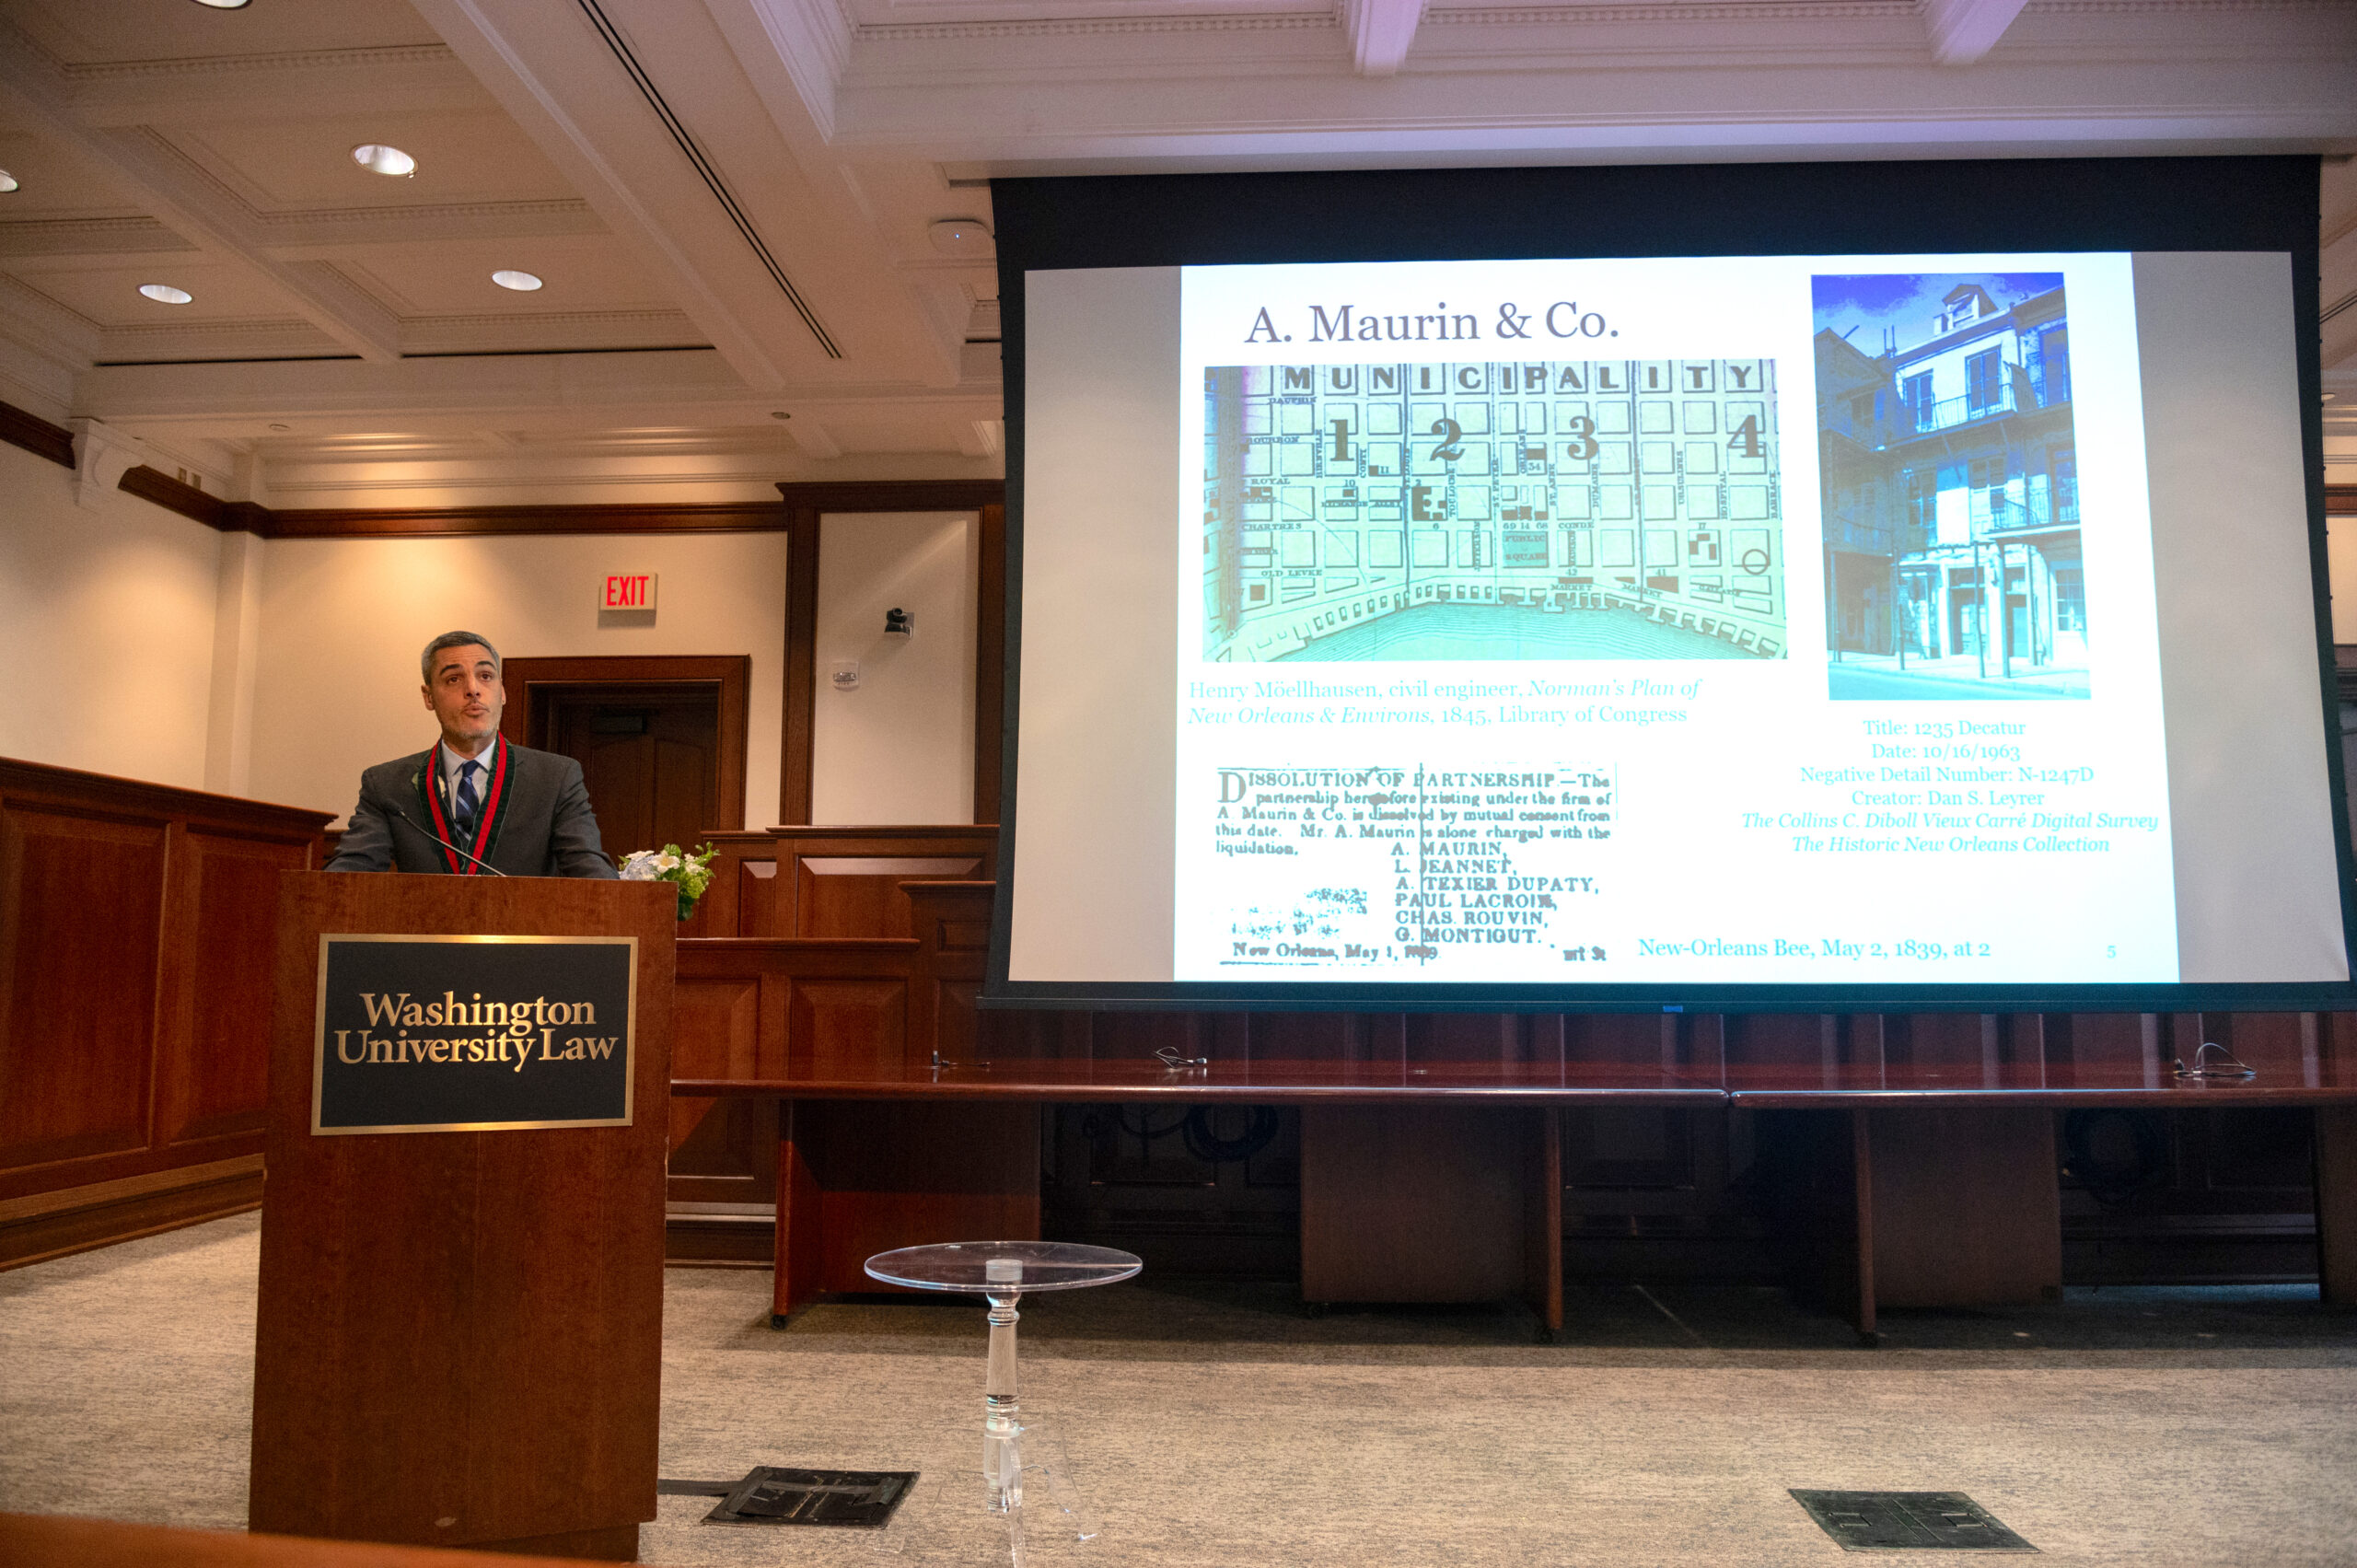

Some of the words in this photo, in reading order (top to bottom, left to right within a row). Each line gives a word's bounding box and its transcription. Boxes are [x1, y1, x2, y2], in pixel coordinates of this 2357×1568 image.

[1245, 307, 1292, 343] A.
[1309, 305, 1480, 342] Maurin
[1495, 302, 1532, 339] &
[1546, 302, 1619, 338] Co.
[1329, 419, 1354, 461] 1
[1429, 418, 1466, 461] 2
[1567, 415, 1599, 460] 3
[1726, 414, 1766, 458] 4
[607, 576, 649, 606] EXIT
[1190, 682, 1248, 702] Henry
[1254, 680, 1382, 700] Möellhausen,
[1389, 680, 1428, 697] civil
[1434, 685, 1523, 701] engineer,
[1631, 680, 1674, 696] Plan
[1680, 679, 1703, 700] of
[1188, 708, 1232, 724] New
[1238, 707, 1315, 724] Orleans
[1319, 707, 1336, 723] &
[1341, 707, 1434, 725] Environs,
[1443, 707, 1492, 726] 1845,
[1499, 705, 1567, 726] Library
[1575, 705, 1595, 722] of
[1599, 706, 1687, 726] Congress
[1864, 719, 1908, 735] Title:
[1915, 723, 1954, 738] 1235
[1959, 720, 2026, 735] Decatur
[1872, 744, 1917, 759] Date:
[1922, 744, 2020, 761] 10/16/1963
[1800, 767, 1875, 785] Negative
[1880, 766, 1931, 782] Detail
[1937, 766, 2013, 782] Number:
[2018, 767, 2094, 785] N-1247D
[1486, 790, 1528, 805] under
[1532, 790, 1556, 805] the
[1852, 790, 1922, 806] Creator:
[1928, 790, 1963, 806] Dan
[1968, 791, 1983, 805] S.
[1989, 790, 2045, 809] Leyrer
[1303, 807, 1316, 820] &
[1440, 808, 1457, 825] by
[1464, 807, 1514, 821] mutual
[1742, 812, 1773, 828] The
[1779, 812, 1838, 828] Collins
[1842, 813, 1859, 828] C.
[1864, 812, 1918, 828] Diboll
[1923, 813, 1971, 828] Vieux
[1976, 812, 2026, 828] Carré
[2031, 812, 2092, 831] Digital
[2096, 813, 2158, 831] Survey
[1359, 824, 1415, 839] Maurin
[1437, 823, 1478, 839] alone
[1550, 825, 1583, 839] with
[1587, 825, 1611, 840] the
[1390, 842, 1410, 856] A.
[1793, 836, 1824, 852] The
[1829, 837, 1899, 852] Historic
[1903, 836, 1945, 852] New
[1949, 836, 2018, 852] Orleans
[2023, 836, 2109, 852] Collection
[1396, 877, 1414, 890] A.
[1396, 893, 1453, 909] PAUL
[1344, 943, 1379, 962] May
[1638, 937, 1768, 956] New-Orleans
[1773, 939, 1816, 959] Bee,
[1821, 939, 1865, 961] May
[1870, 943, 1888, 959] 2,
[1895, 939, 1948, 960] 1839,
[1954, 941, 1973, 957] at
[1979, 943, 1991, 957] 2
[2107, 945, 2117, 959] 5
[358, 991, 597, 1037] Washington
[334, 1028, 537, 1073] University
[539, 1028, 619, 1061] Law
